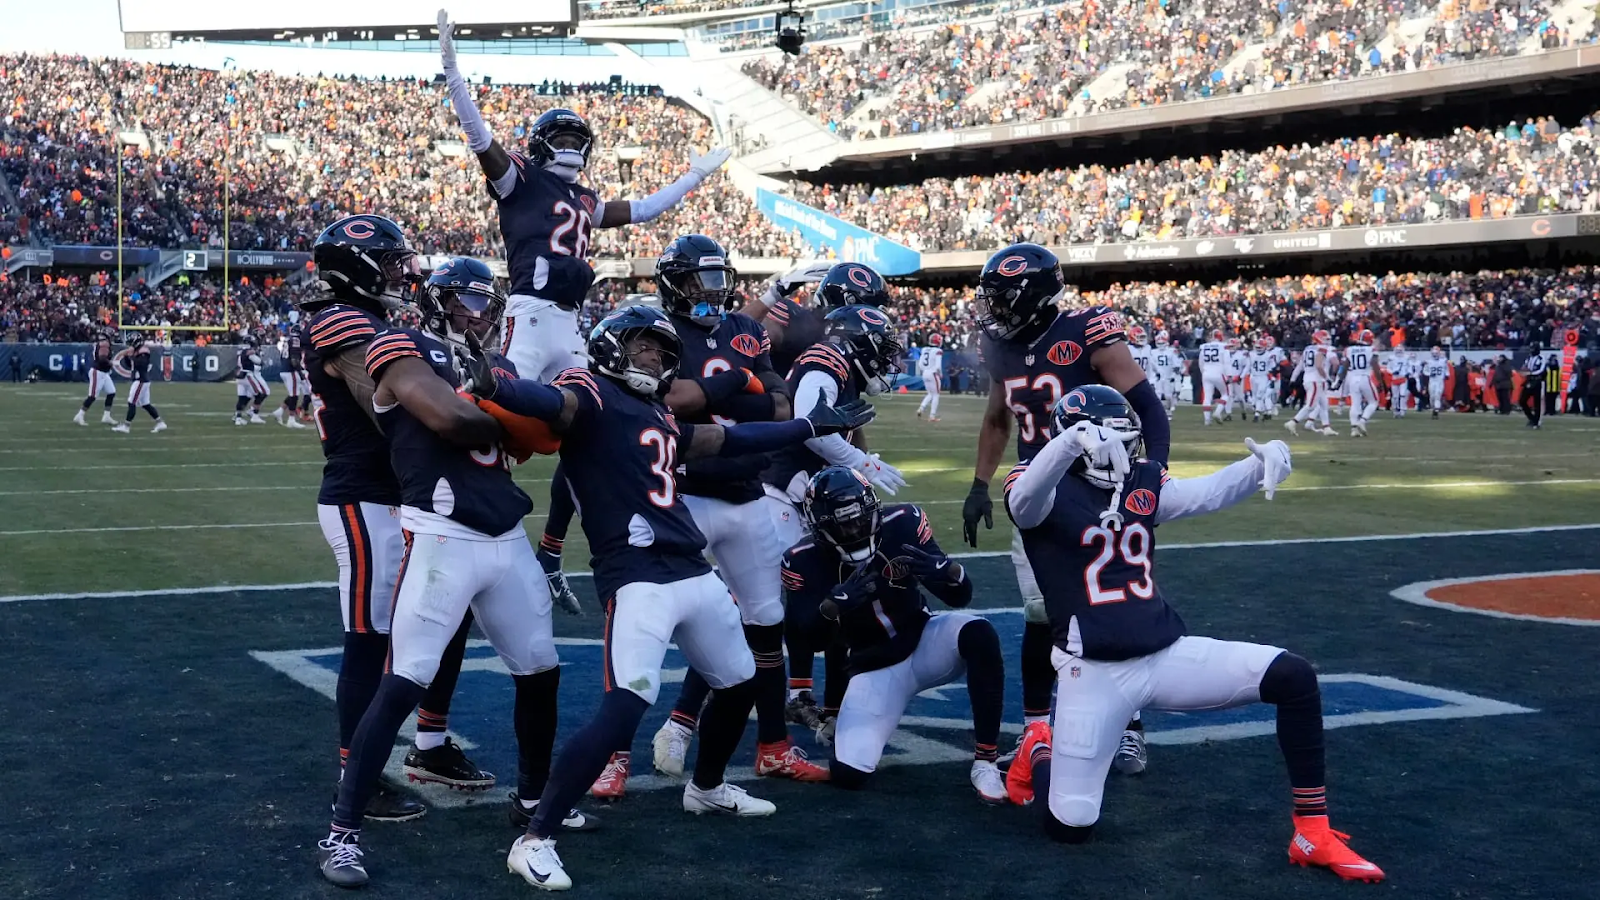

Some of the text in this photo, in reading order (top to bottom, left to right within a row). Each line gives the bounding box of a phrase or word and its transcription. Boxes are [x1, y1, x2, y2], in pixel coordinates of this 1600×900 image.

[343, 220, 375, 239] C
[550, 200, 591, 260] 26
[1379, 230, 1407, 244] PNC
[854, 236, 880, 262] PNC
[1273, 236, 1318, 249] UNITED
[430, 350, 447, 363] C
[922, 352, 930, 367] 3
[1157, 355, 1169, 366] 51
[1203, 348, 1219, 363] 52
[1351, 353, 1367, 370] 10
[1252, 360, 1266, 372] 43
[1004, 372, 1064, 443] 53
[1080, 521, 1153, 606] 29
[1294, 832, 1315, 856] NIKE
